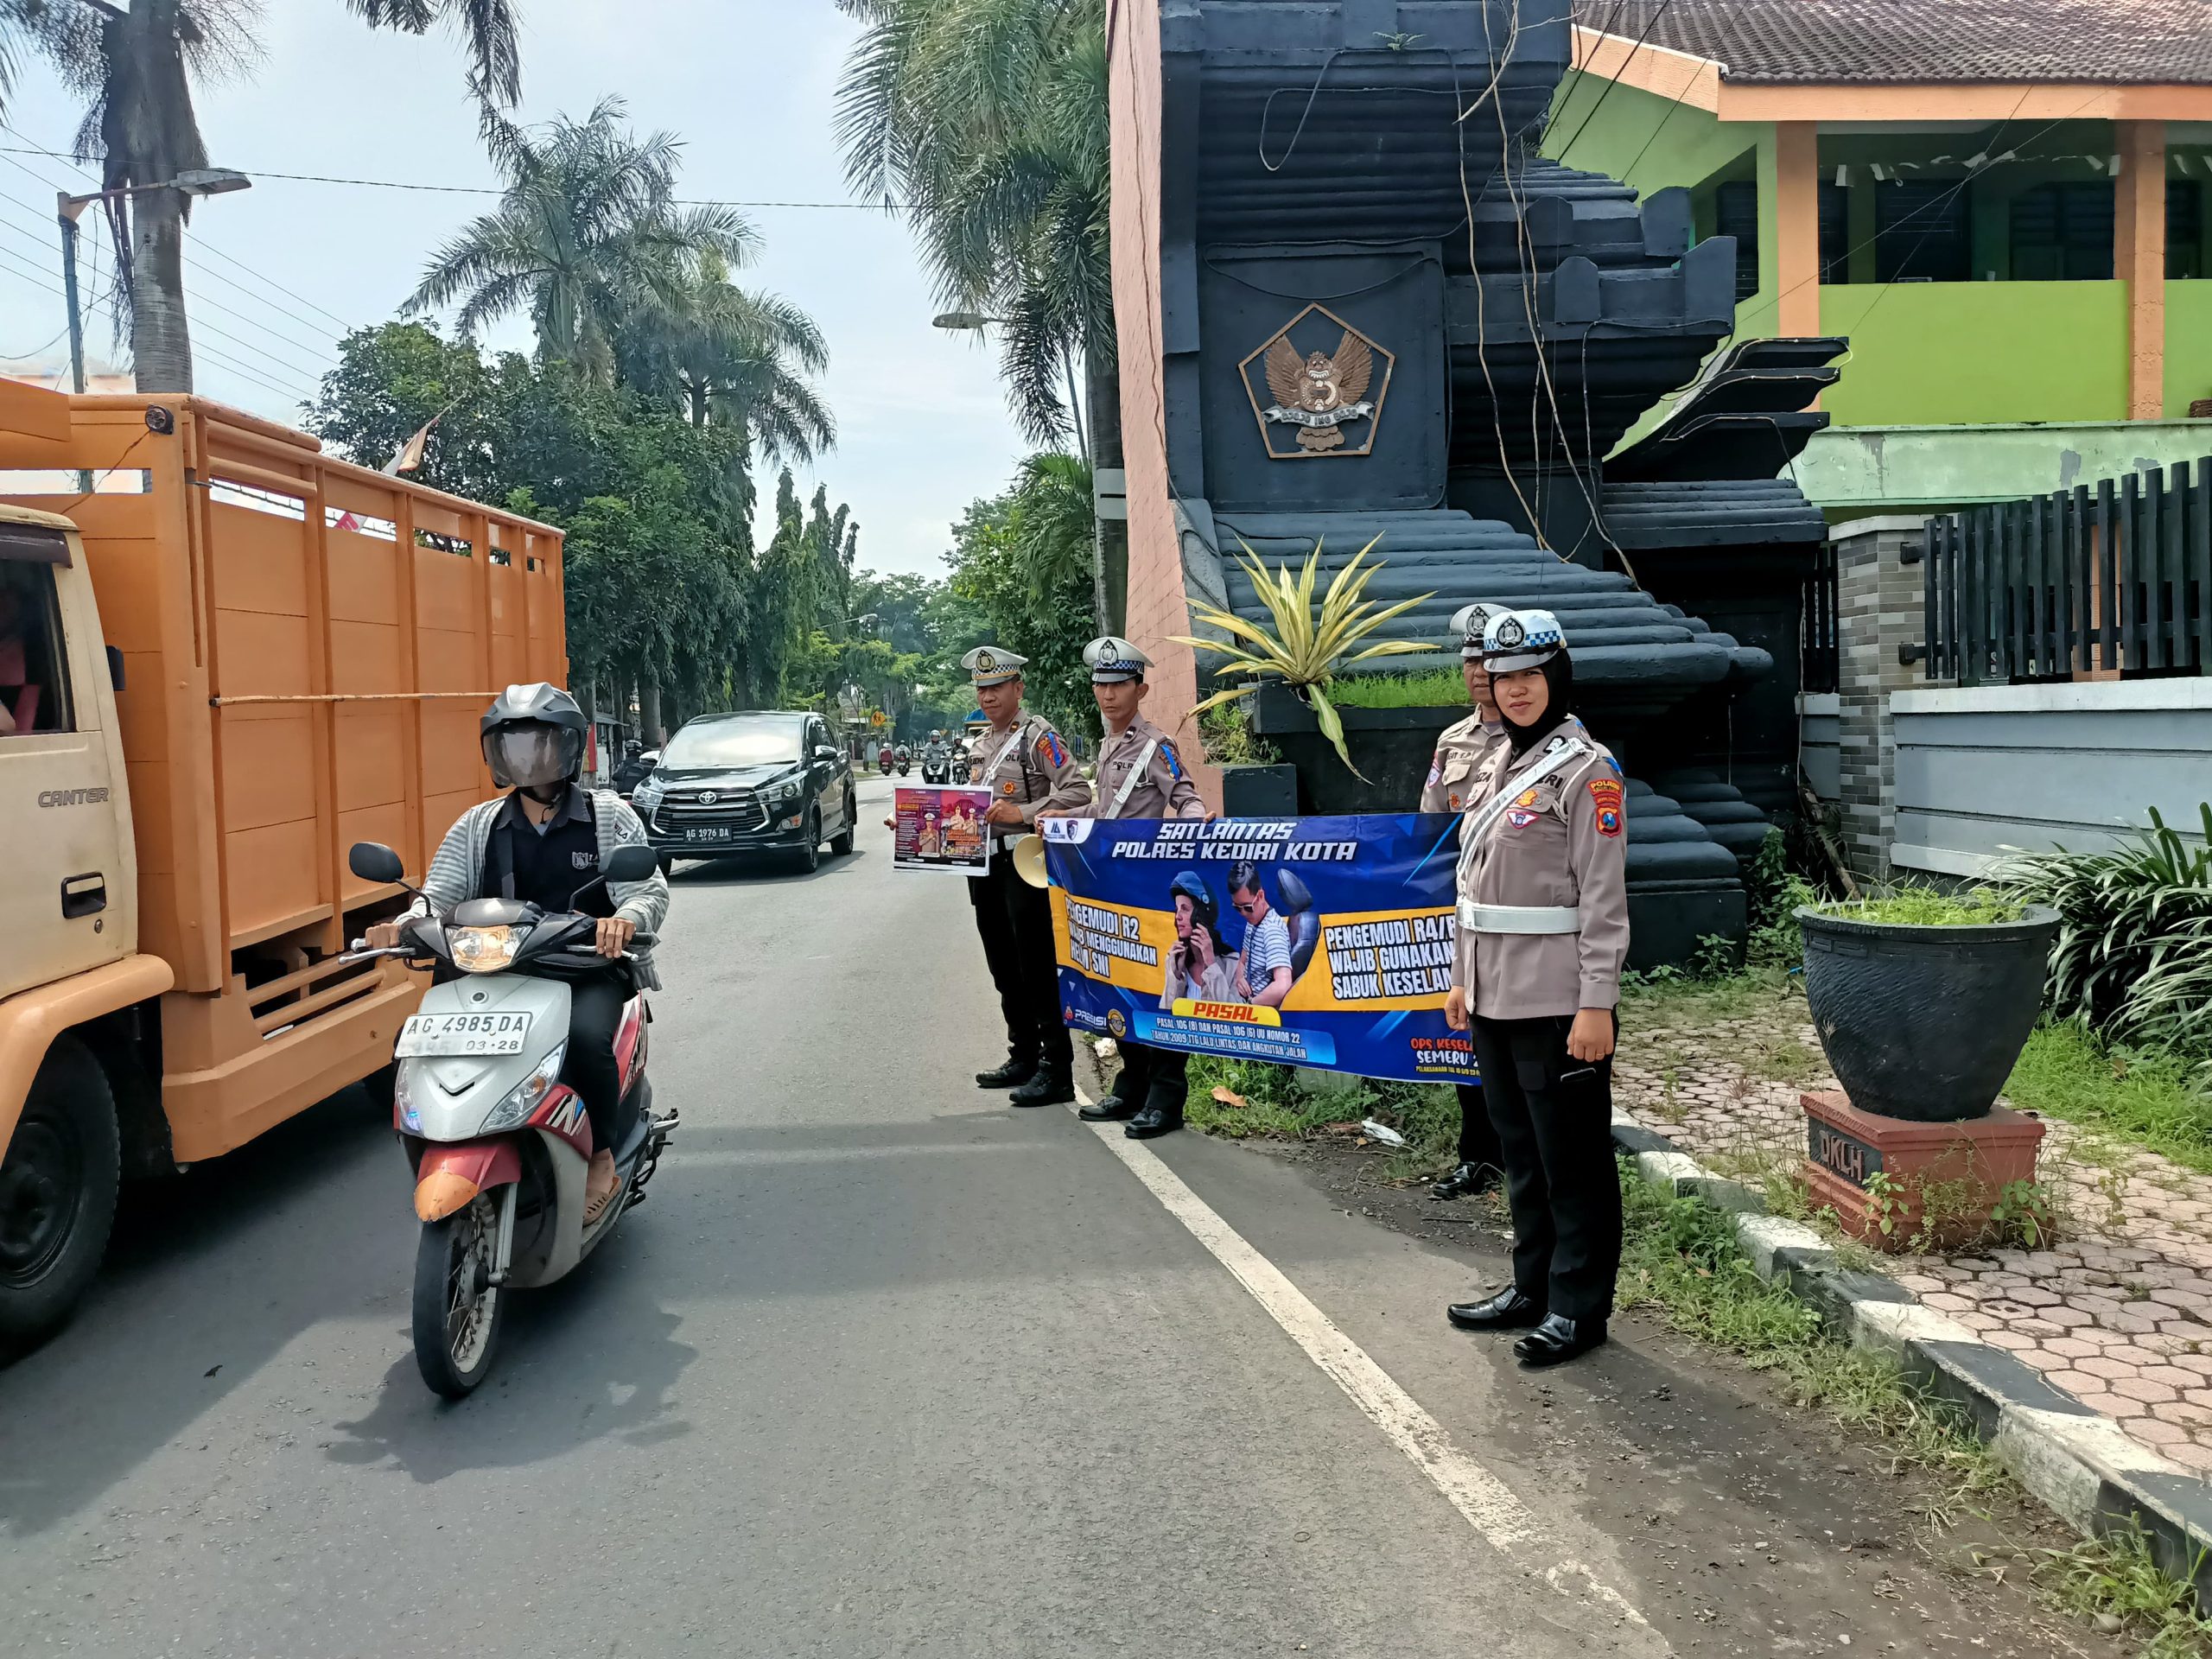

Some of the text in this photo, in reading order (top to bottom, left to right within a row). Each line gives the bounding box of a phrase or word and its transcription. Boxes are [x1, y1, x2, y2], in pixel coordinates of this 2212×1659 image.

[38, 787, 109, 807] CANTER
[686, 828, 729, 838] AG 1976 DA
[1157, 823, 1297, 840] SATLANTAS
[1112, 842, 1357, 861] POLRES KEDIRI KOTA
[1122, 914, 1140, 940] R2
[1325, 920, 1410, 950] PENGEMUDI
[1085, 930, 1157, 966] MENGGUNAKAN
[1329, 941, 1455, 975] WAJIB GUNAKAN
[1092, 951, 1110, 978] SNI
[1332, 974, 1381, 999] SABUK
[1193, 1001, 1258, 1022] PASAL
[407, 1016, 523, 1035] AG 4985 DA
[1156, 1017, 1175, 1029] PASAL
[1176, 1020, 1187, 1030] 106
[1198, 1022, 1211, 1033] DAN
[1212, 1024, 1232, 1035] PASAL
[1233, 1026, 1245, 1036] 106
[1256, 1028, 1265, 1039] UU
[1267, 1030, 1290, 1043] NOMOR
[1291, 1033, 1300, 1044] 22
[1171, 1033, 1187, 1044] 2009
[1215, 1038, 1236, 1050] LINTAS
[1286, 1046, 1306, 1059] JALAN
[1410, 1038, 1433, 1049] OPS
[1416, 1051, 1469, 1065] SEMERU
[1818, 1129, 1866, 1182] DKLH
